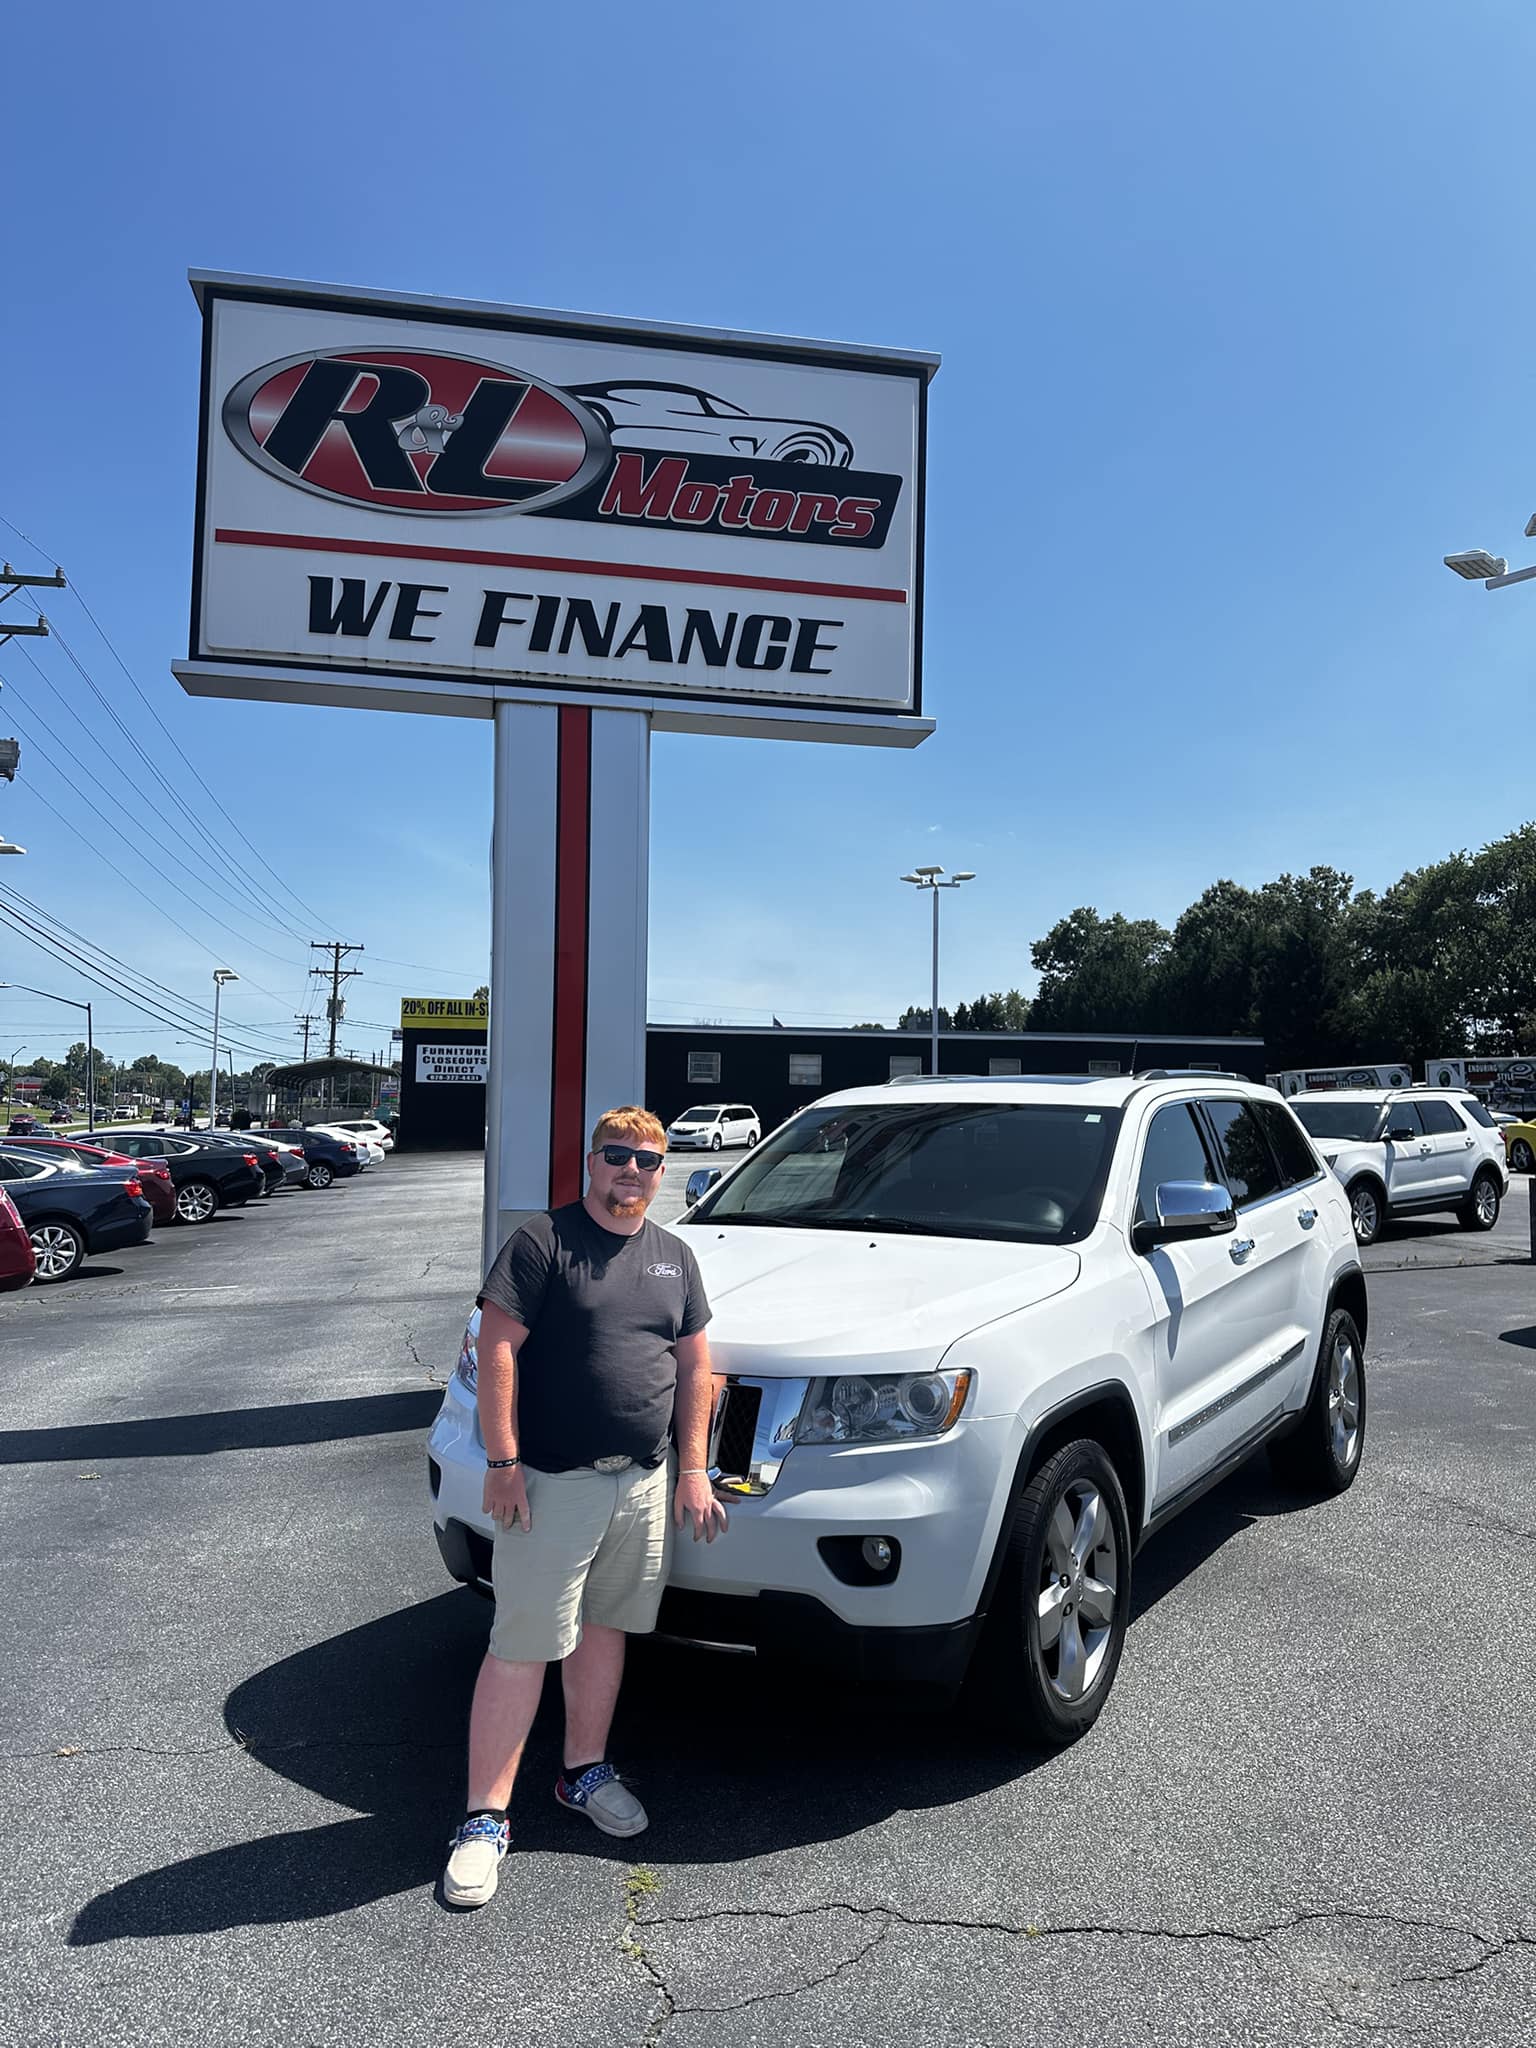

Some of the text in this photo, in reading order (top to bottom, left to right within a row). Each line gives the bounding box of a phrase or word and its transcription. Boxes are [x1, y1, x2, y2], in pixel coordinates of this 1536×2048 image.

[260, 357, 571, 501] R&L
[598, 451, 883, 540] Motors
[307, 575, 844, 675] WE FINANCE
[403, 1000, 426, 1015] 20%
[428, 1001, 446, 1015] OFF
[447, 1002, 463, 1016] ALL
[422, 1047, 488, 1056] FURNITURE
[422, 1056, 488, 1065] CLOSEOUTS
[434, 1065, 475, 1073] DIRECT
[1468, 1064, 1498, 1073] ENDURING
[1497, 1073, 1514, 1081] STYLE
